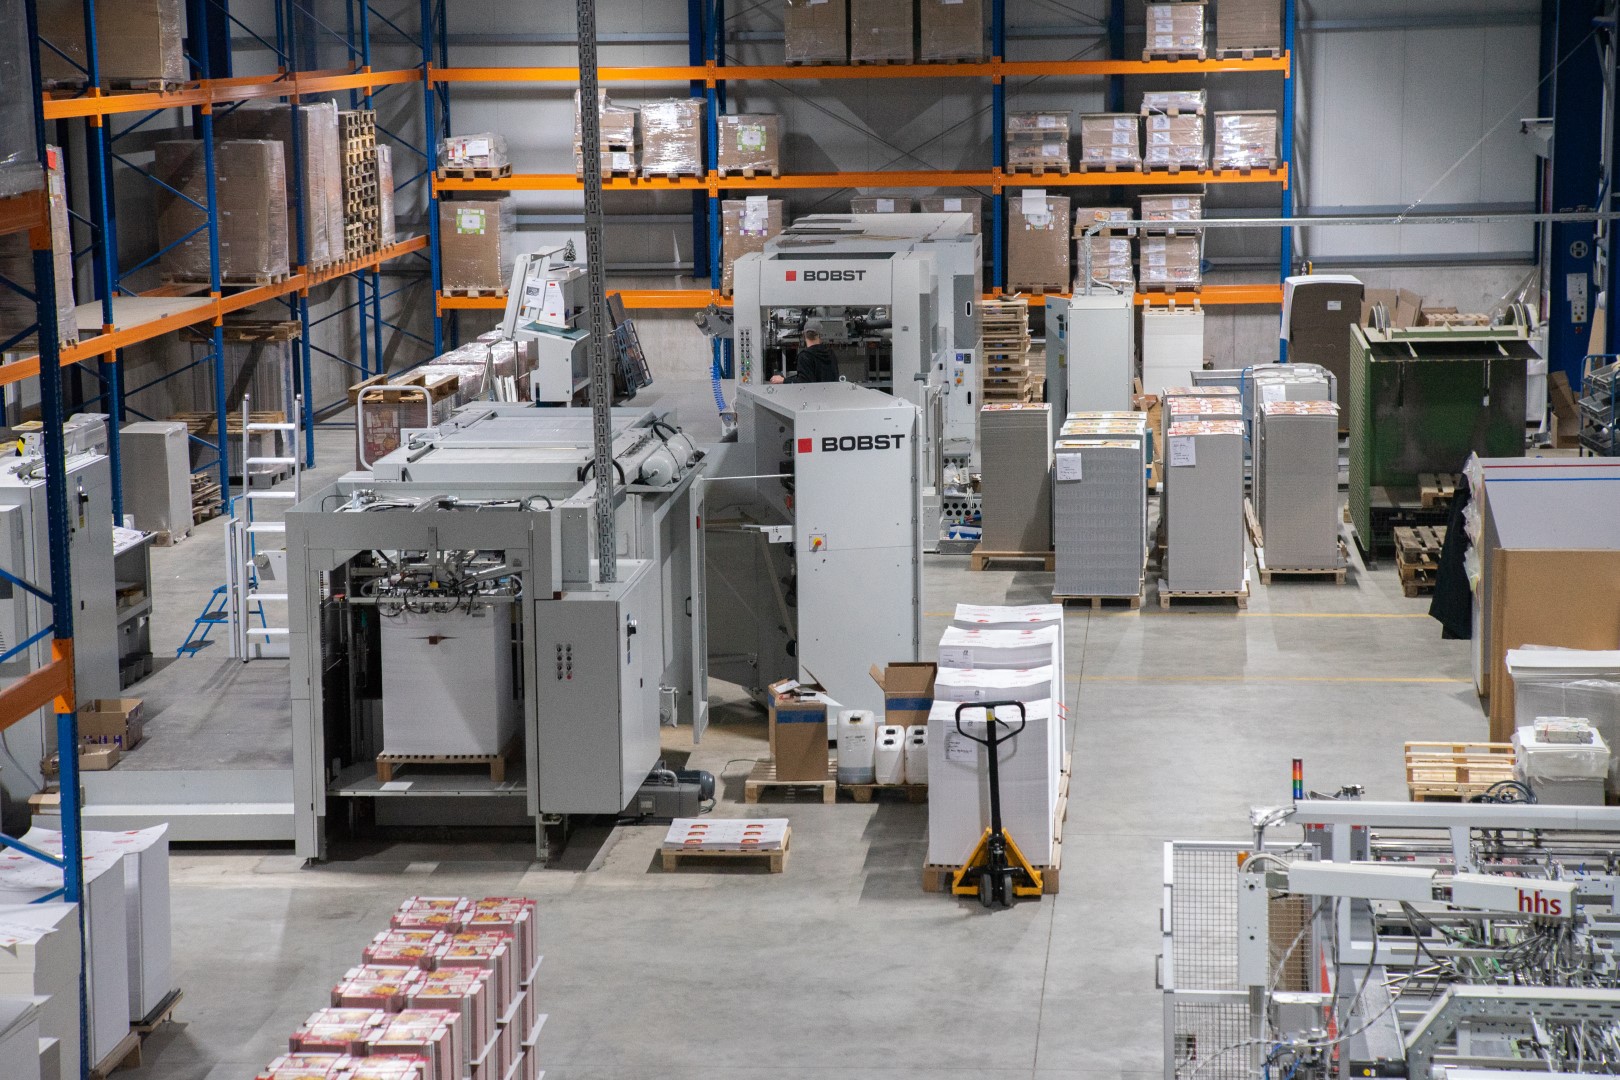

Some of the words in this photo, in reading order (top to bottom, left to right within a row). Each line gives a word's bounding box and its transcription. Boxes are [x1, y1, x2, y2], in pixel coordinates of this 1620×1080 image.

[804, 270, 866, 281] BOBST
[822, 434, 905, 452] BOBST
[1518, 890, 1561, 916] hhs
